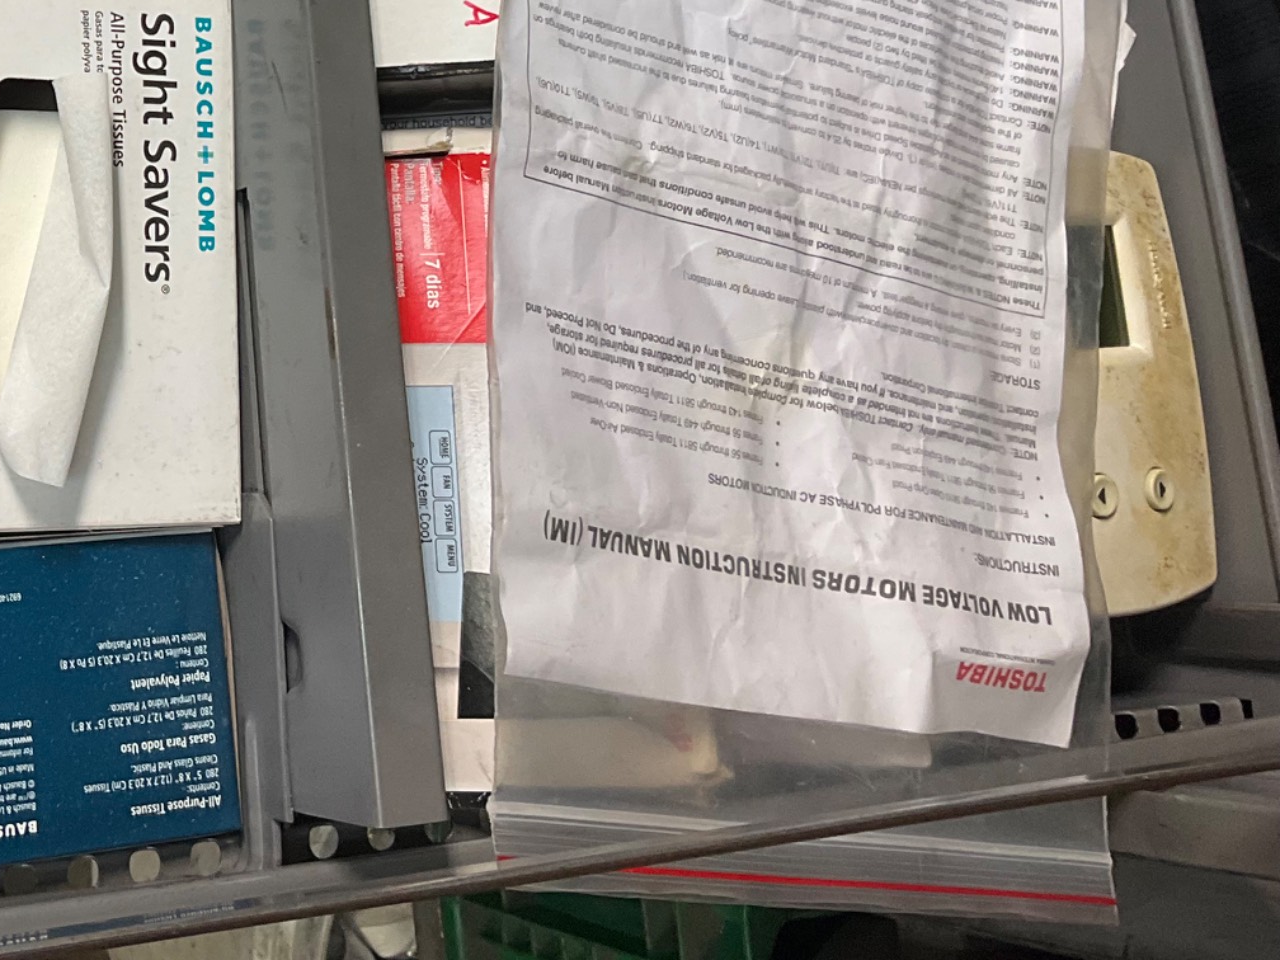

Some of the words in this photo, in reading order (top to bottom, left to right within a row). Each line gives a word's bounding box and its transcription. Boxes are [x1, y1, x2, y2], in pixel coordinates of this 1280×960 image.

[78, 8, 90, 40] papier
[93, 9, 104, 37] Gasas
[92, 39, 105, 62] para
[109, 11, 126, 105] All-Purpose
[130, 11, 178, 126] Sight
[412, 115, 476, 128] household
[111, 109, 127, 168] Tissues
[191, 16, 217, 253] BAUSCH+LOMB
[140, 138, 180, 284] Savers
[655, 196, 694, 215] Motors
[693, 204, 736, 224] Voltage
[393, 227, 403, 250] centro
[423, 257, 440, 269] 7
[395, 262, 405, 297] mensajes
[425, 273, 441, 309] días
[986, 369, 1042, 390] STORAGE
[440, 436, 449, 459] HOME
[415, 456, 429, 509] System:
[442, 474, 451, 489] FAN
[817, 492, 882, 514] POLYPHASE
[418, 512, 432, 543] Cool
[443, 503, 453, 532] SYSTEM
[540, 507, 586, 546] (IM)
[584, 523, 672, 561] MANUAL
[446, 544, 455, 567] MENU
[674, 541, 807, 586] INSTRUCTION
[972, 549, 1060, 578] INSTRUCTIONS:
[809, 566, 916, 602] MOTORS
[919, 582, 1004, 618] VOLTAGE
[1004, 598, 1053, 626] LOW
[129, 671, 180, 691] Polyvalent
[180, 668, 211, 685] Papier
[954, 659, 1048, 693] TOSHIBA
[10, 718, 32, 731] Order
[119, 741, 139, 755] Uso
[140, 738, 164, 752] Todo
[164, 735, 187, 750] Para
[187, 731, 216, 746] Gasas
[129, 761, 157, 774] Plastic.
[157, 759, 173, 770] And
[173, 756, 193, 768] Glass
[193, 753, 218, 765] Cleans
[82, 781, 110, 795] Tissues
[129, 801, 165, 817] Tissues
[166, 793, 222, 813] All-Purpose
